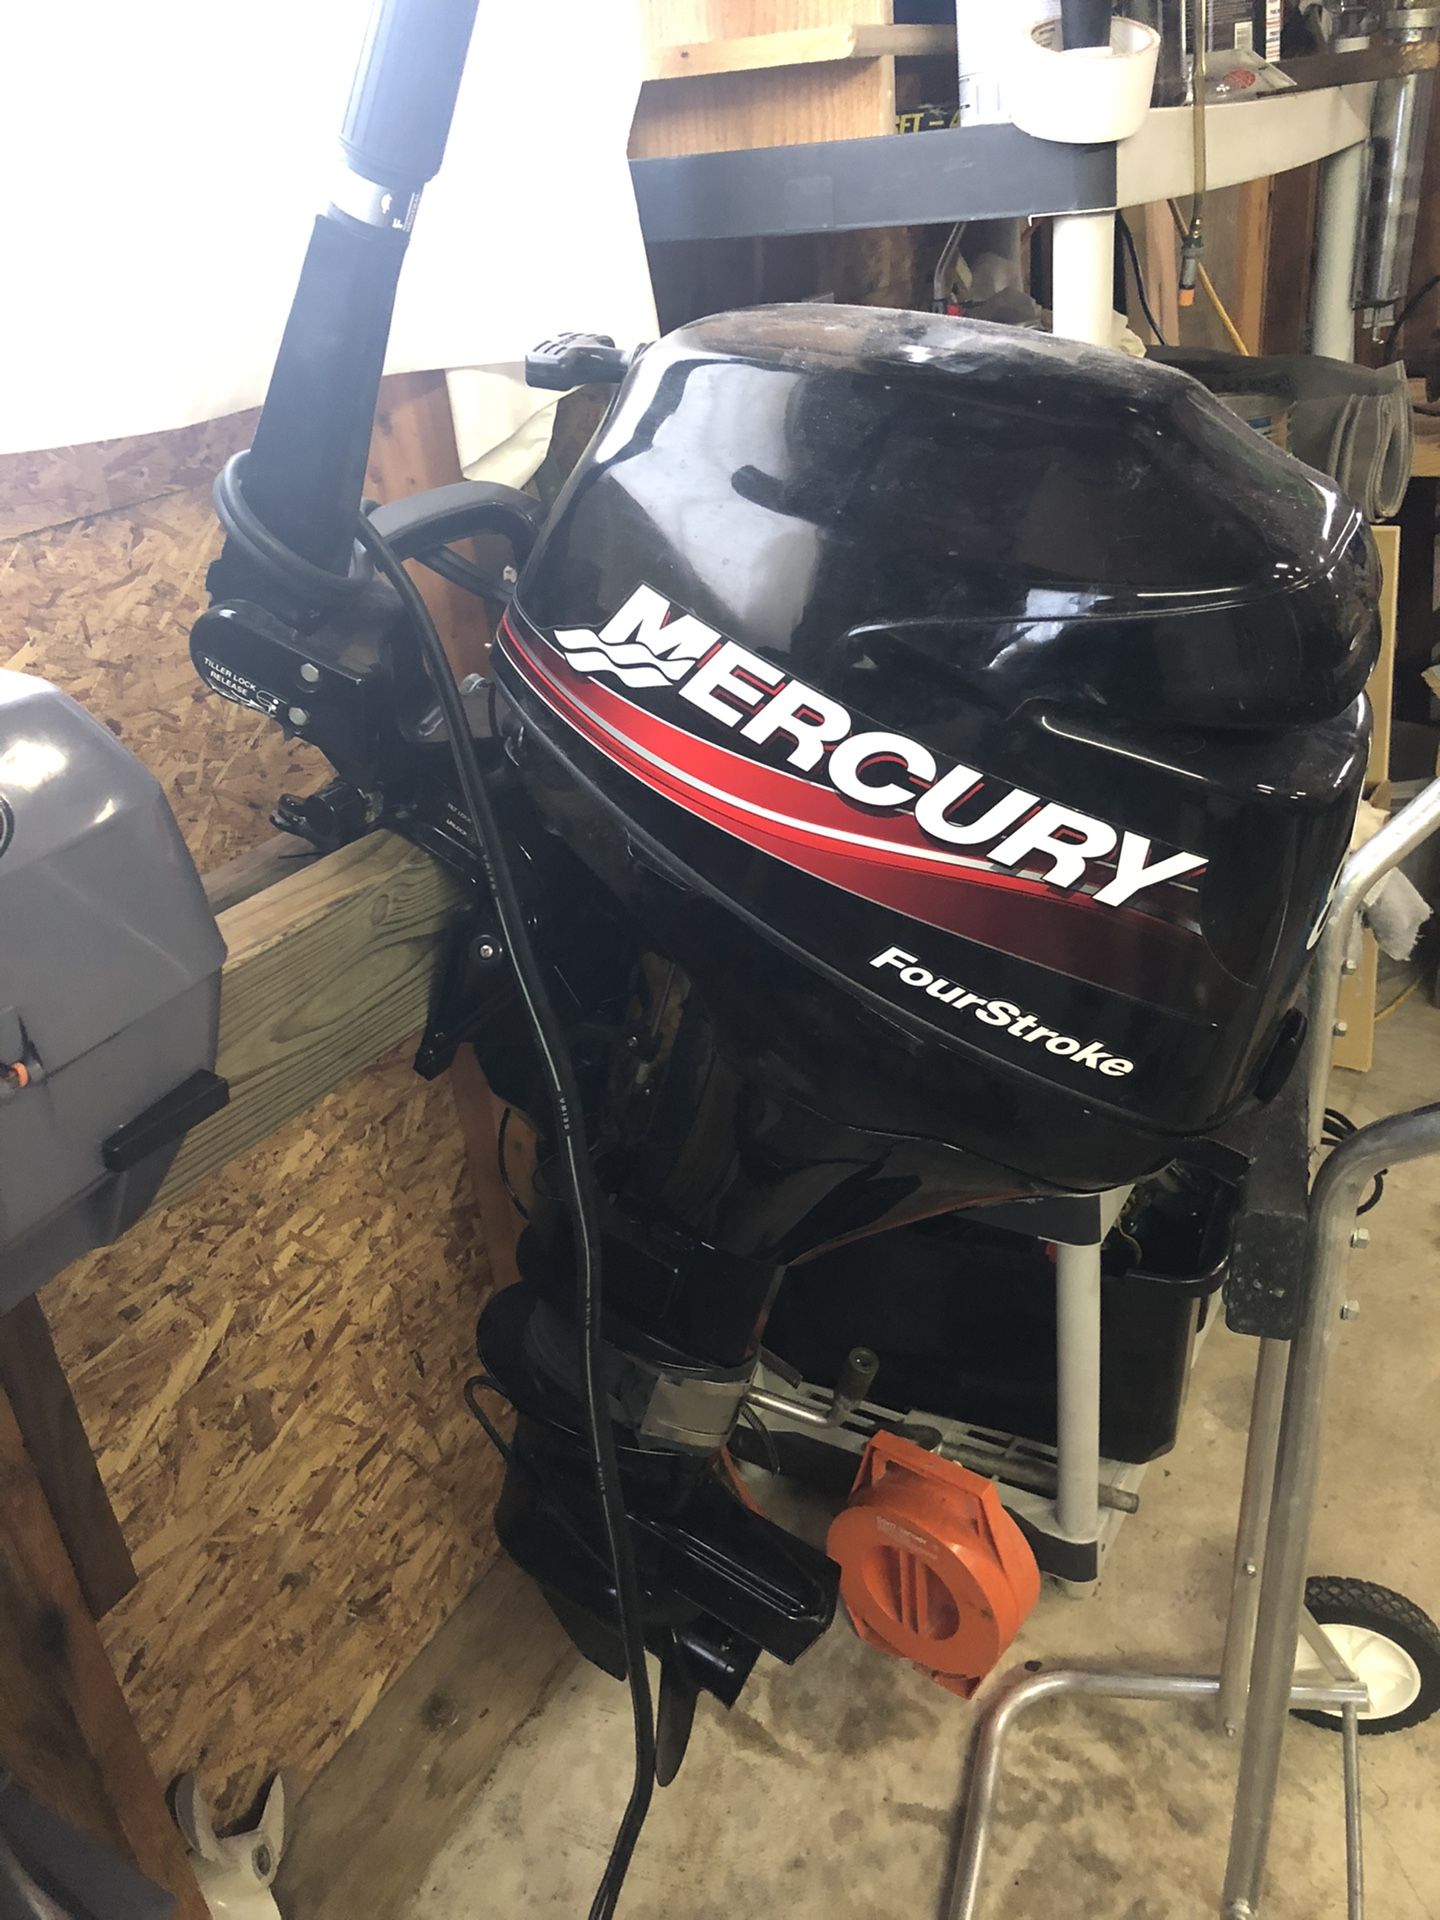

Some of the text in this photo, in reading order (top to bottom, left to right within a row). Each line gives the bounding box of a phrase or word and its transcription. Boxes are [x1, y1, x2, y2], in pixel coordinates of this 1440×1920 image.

[204, 657, 256, 692] TILLER LOCK
[210, 670, 248, 697] RELEASE
[598, 584, 1209, 907] MERCURY
[869, 945, 1135, 1077] FourStroke
